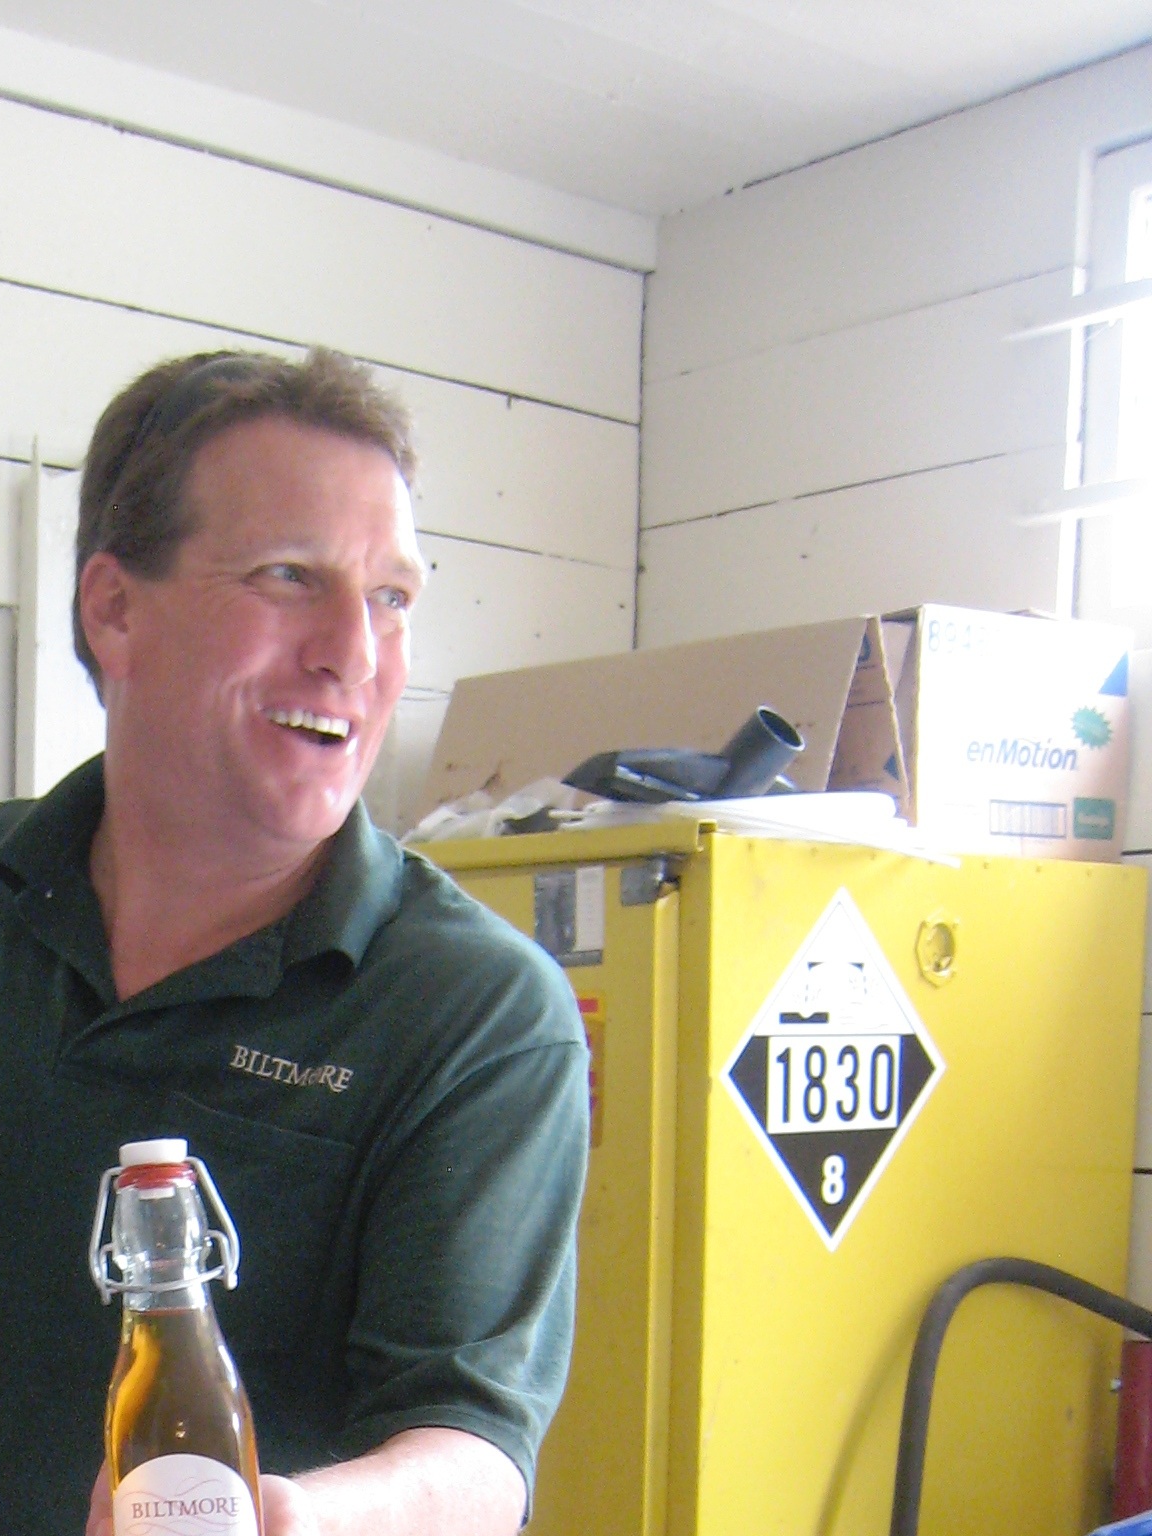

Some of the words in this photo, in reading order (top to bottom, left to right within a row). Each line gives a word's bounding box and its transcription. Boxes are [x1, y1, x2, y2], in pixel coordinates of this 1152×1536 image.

[967, 738, 1078, 771] enMotion
[230, 1045, 354, 1093] BILTMORE
[776, 1044, 896, 1124] 1830
[820, 1154, 847, 1205] 8
[133, 1497, 240, 1518] BILTMORE
